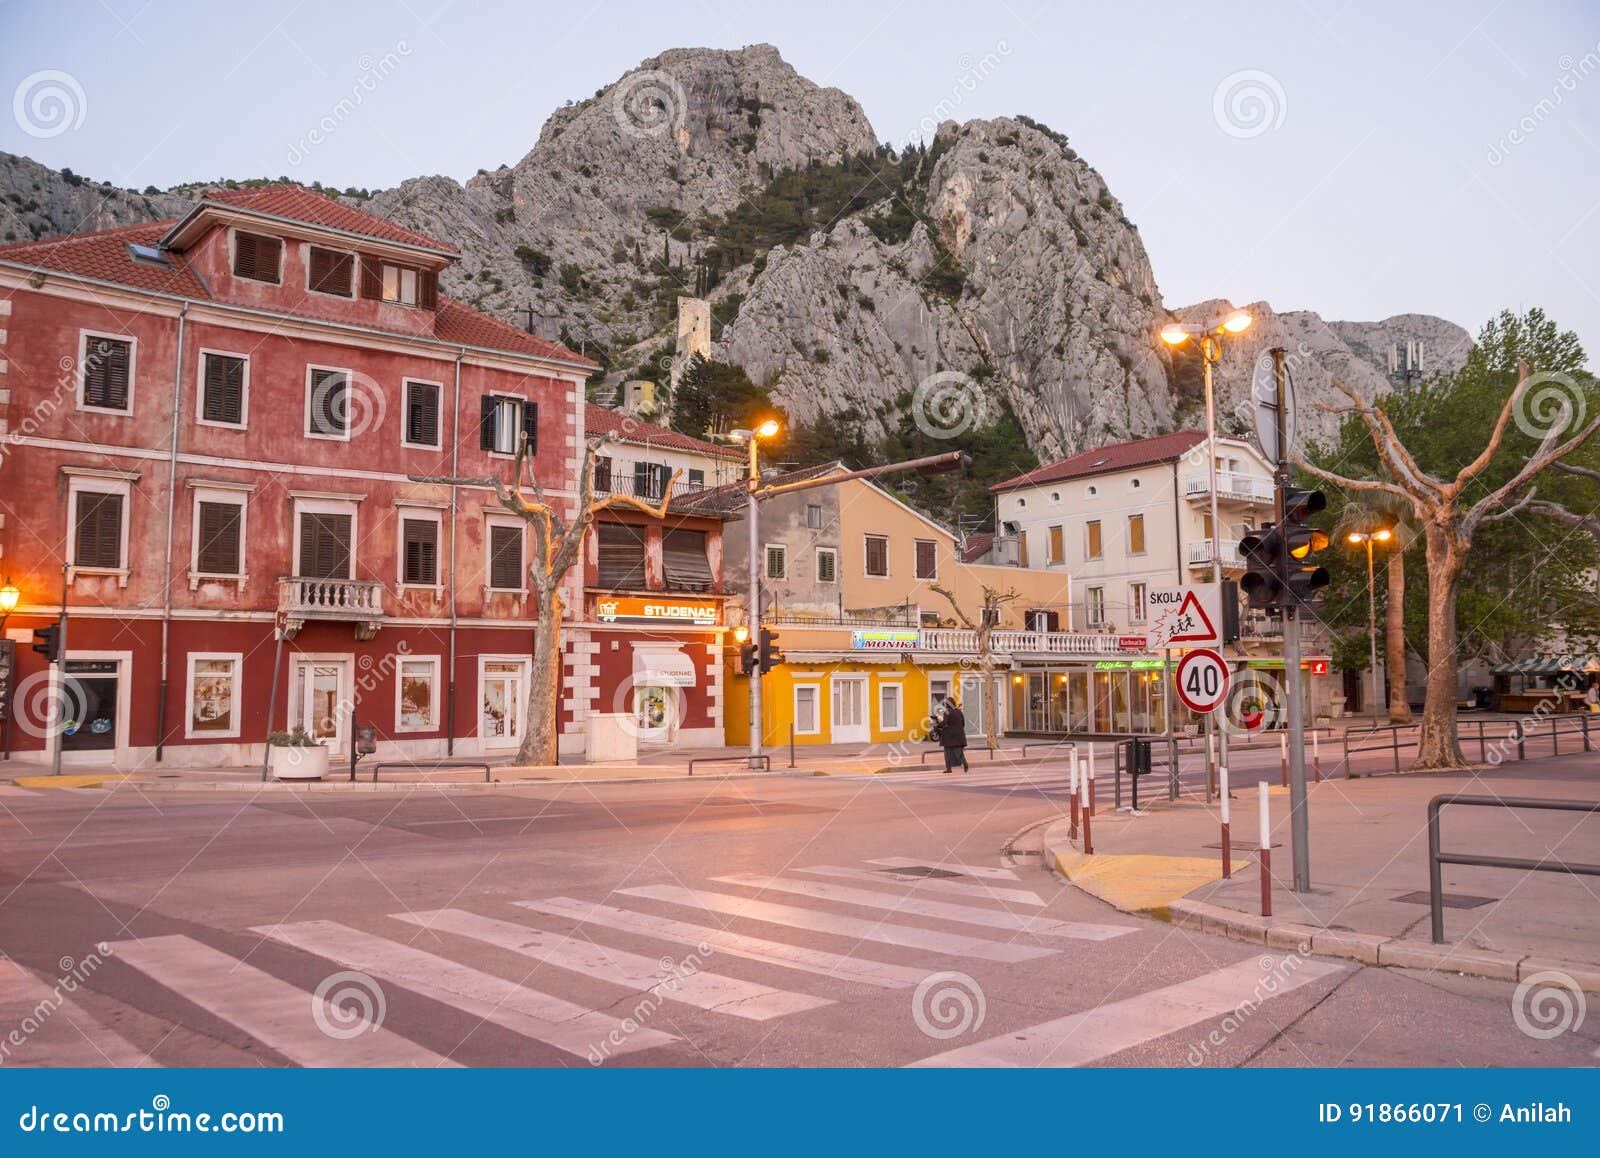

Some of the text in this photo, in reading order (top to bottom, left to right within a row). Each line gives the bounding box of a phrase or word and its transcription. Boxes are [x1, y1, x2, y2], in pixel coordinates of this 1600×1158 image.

[1150, 591, 1182, 604] ŠKOLA
[645, 605, 715, 617] STUDENAC
[1186, 665, 1218, 697] 40
